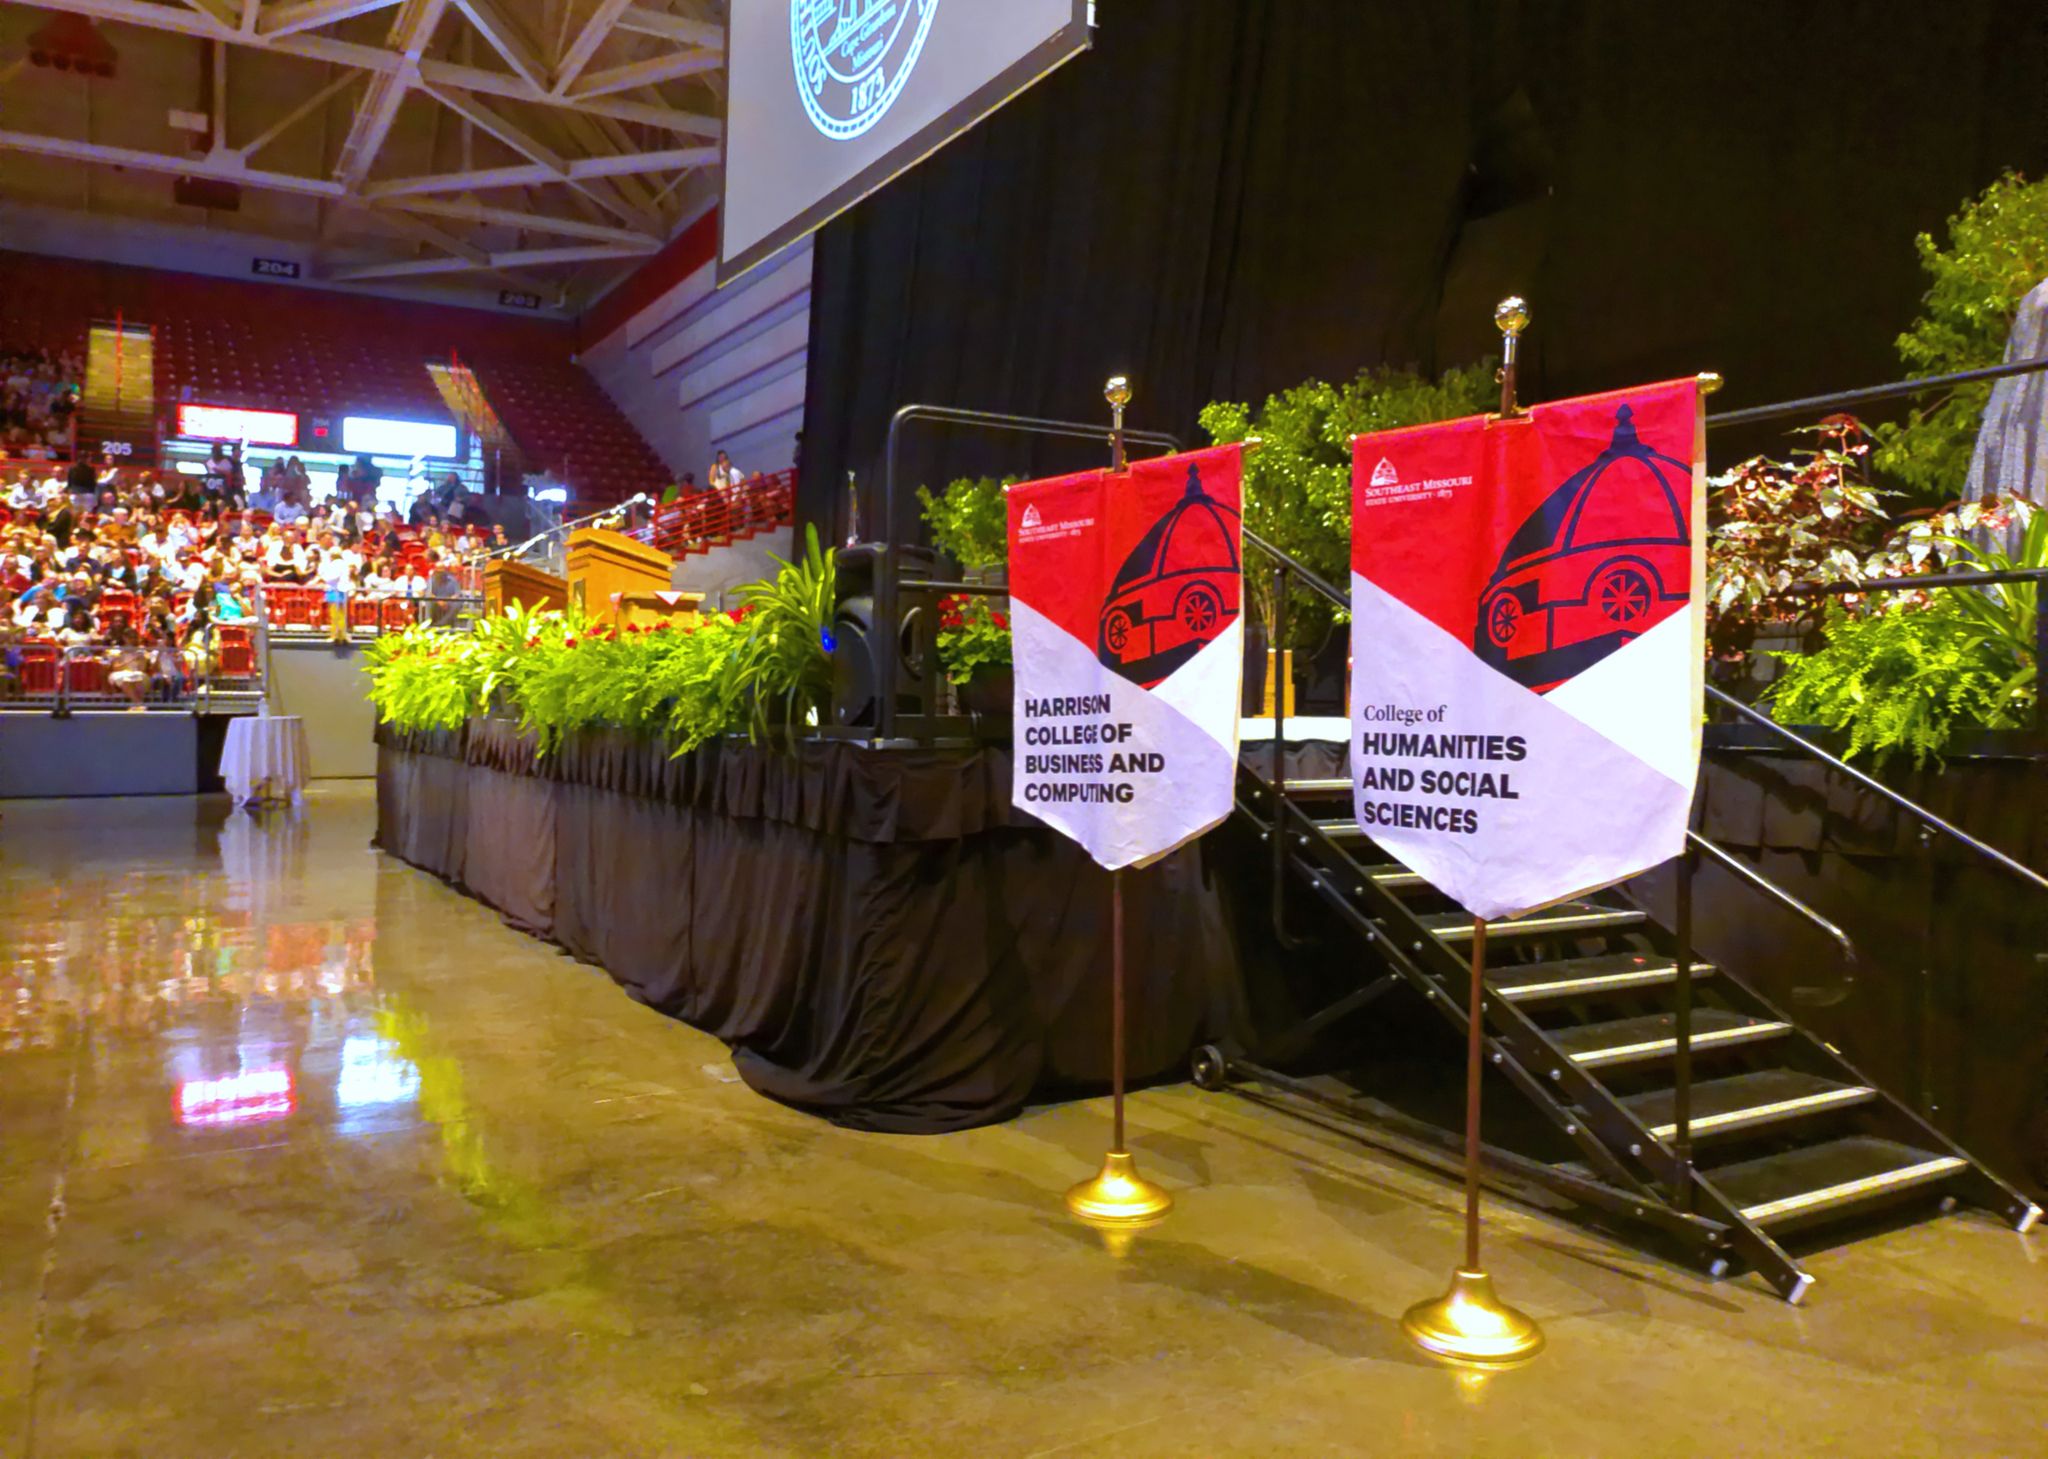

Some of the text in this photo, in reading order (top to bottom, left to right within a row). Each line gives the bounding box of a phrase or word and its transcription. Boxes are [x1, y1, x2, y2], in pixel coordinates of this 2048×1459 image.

[850, 66, 885, 115] 1873
[259, 261, 294, 275] 204
[101, 441, 132, 456] 205
[1365, 476, 1472, 498] SOUTHEAST MISSOURI
[1025, 694, 1111, 718] HARRISON
[1363, 705, 1448, 727] College of
[1025, 723, 1133, 745] COLLEGE OF
[1363, 732, 1527, 761] HUMANITIES
[1025, 753, 1165, 774] BUSINESS AND
[1025, 783, 1135, 803] COMPUTING
[1362, 767, 1519, 799] AND SOCIAL
[1364, 801, 1478, 834] SCIENCES
